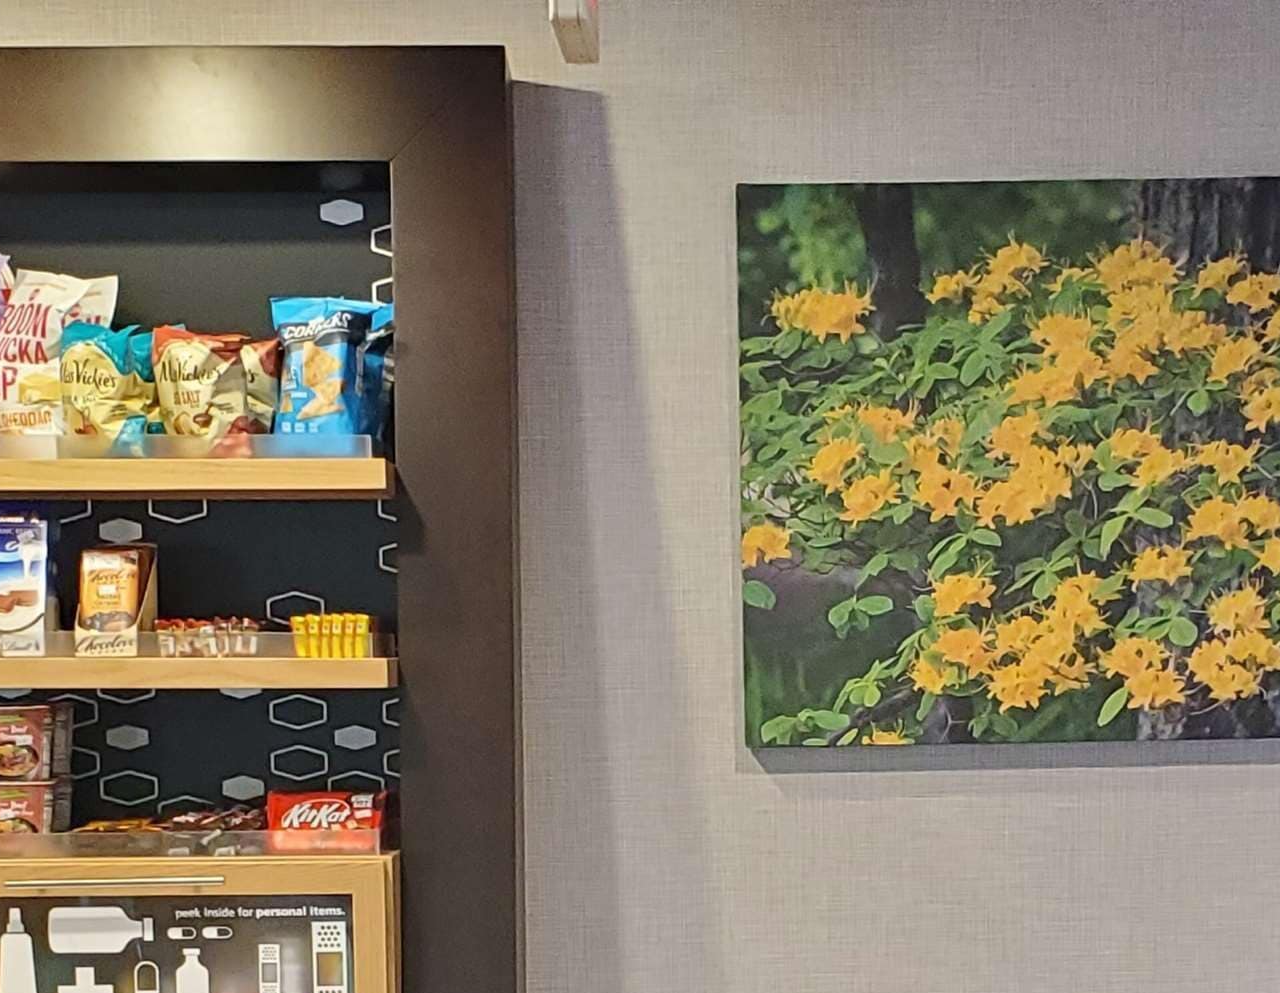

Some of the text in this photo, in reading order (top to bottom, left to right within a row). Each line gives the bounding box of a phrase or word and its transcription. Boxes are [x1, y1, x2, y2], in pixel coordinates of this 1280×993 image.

[175, 907, 202, 921] peek
[203, 906, 235, 918] inside
[237, 906, 255, 918] for
[255, 906, 308, 920] personal
